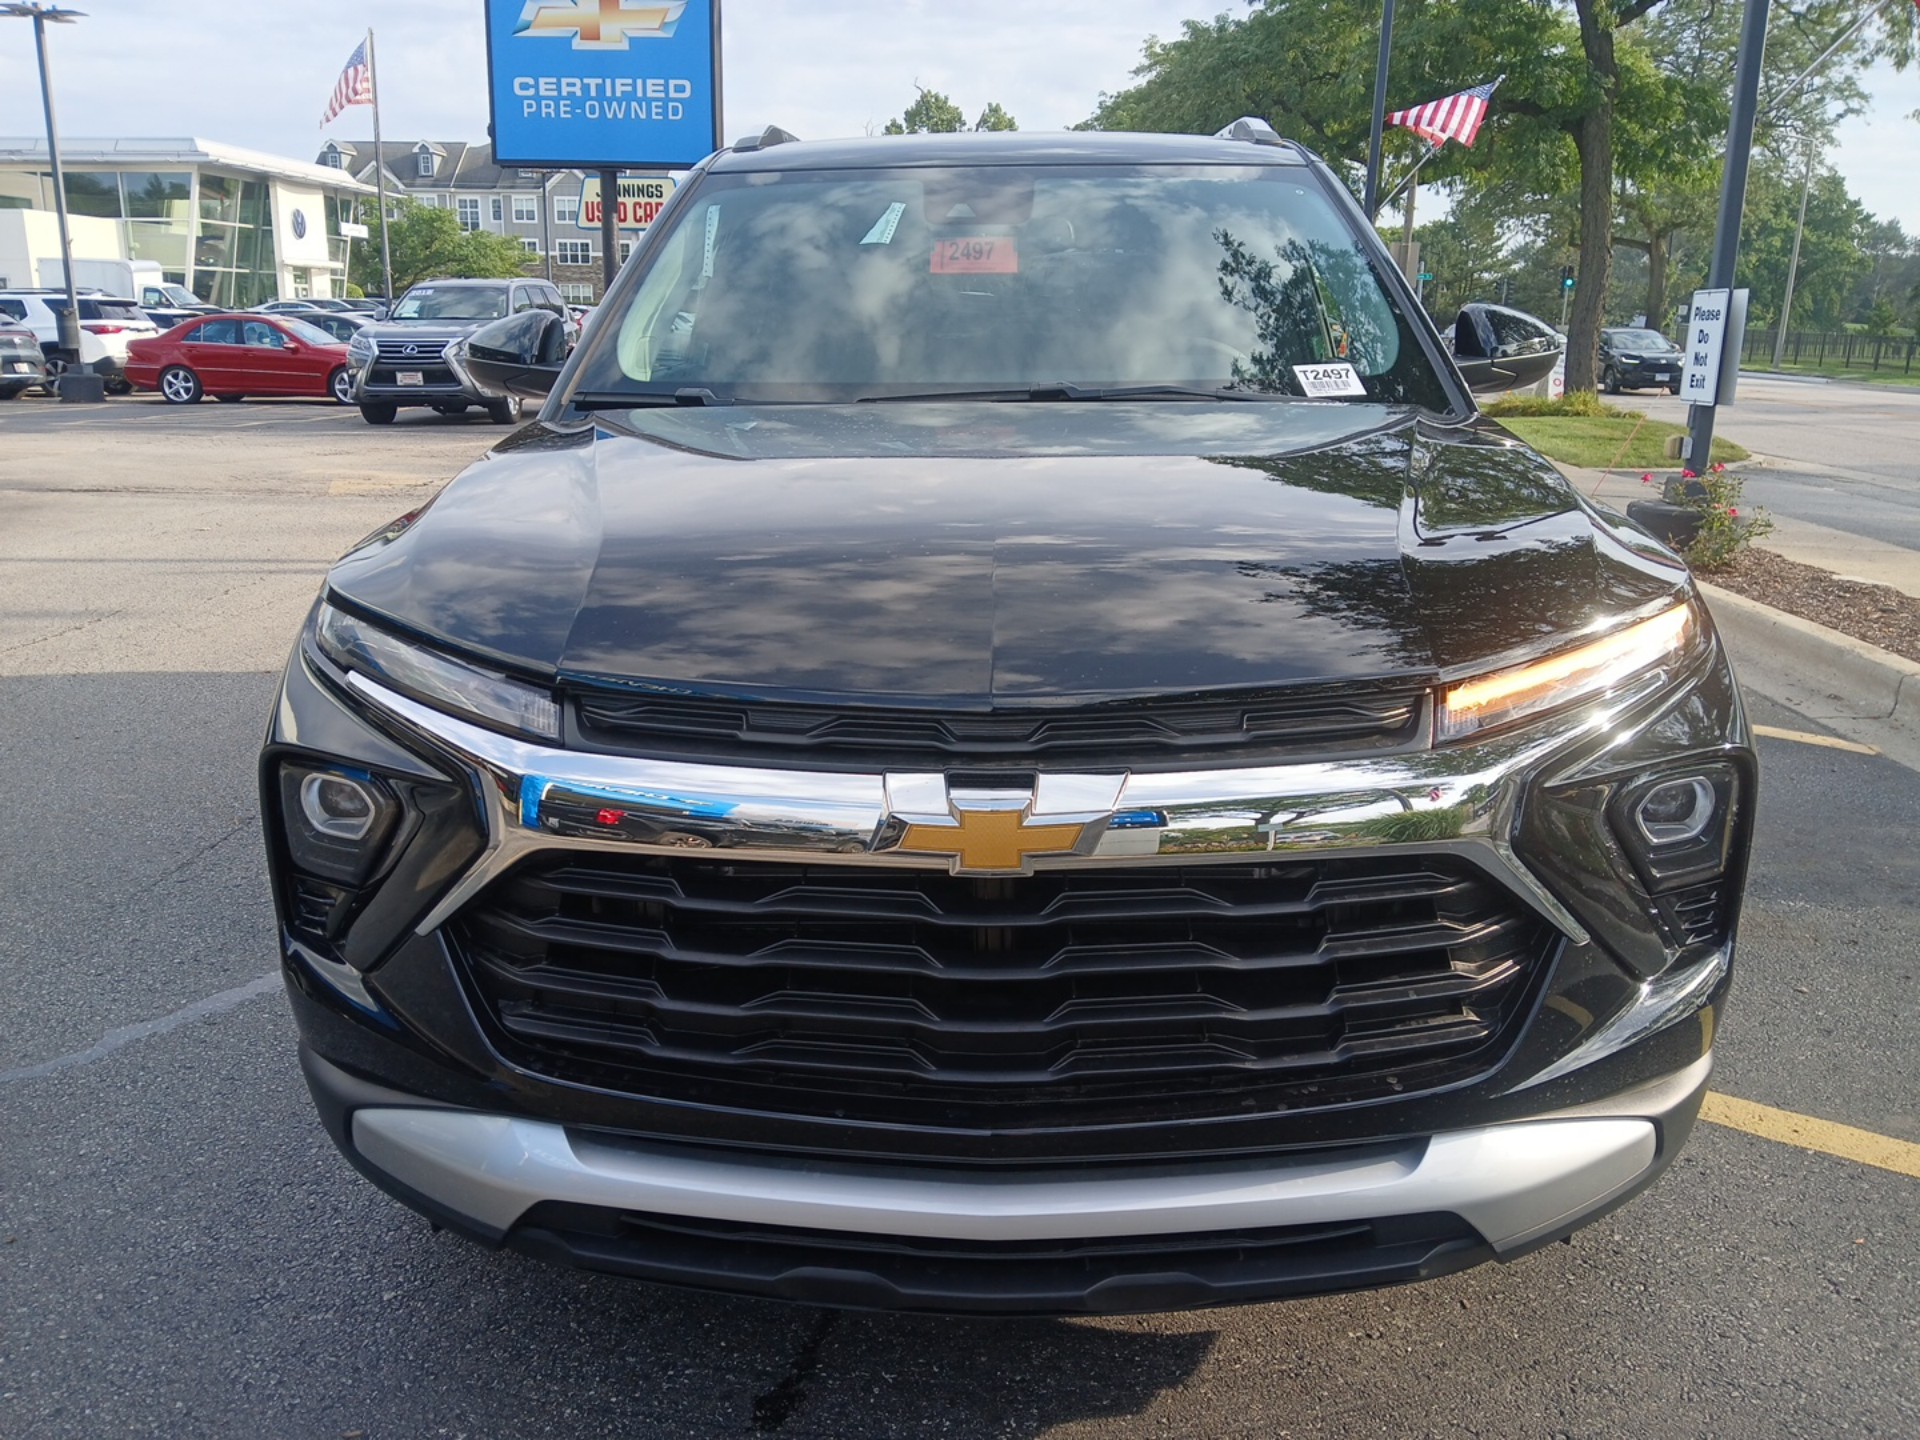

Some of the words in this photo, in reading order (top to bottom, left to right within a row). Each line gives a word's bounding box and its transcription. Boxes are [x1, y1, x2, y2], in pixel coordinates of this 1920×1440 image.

[513, 76, 692, 99] CERTIFIED
[523, 100, 684, 120] PRE-OWNED
[585, 201, 628, 223] USD
[1694, 306, 1721, 321] Please
[1697, 329, 1709, 344] Do
[1693, 352, 1708, 366] Not
[1299, 368, 1350, 380] T2497
[1689, 374, 1705, 389] Exit
